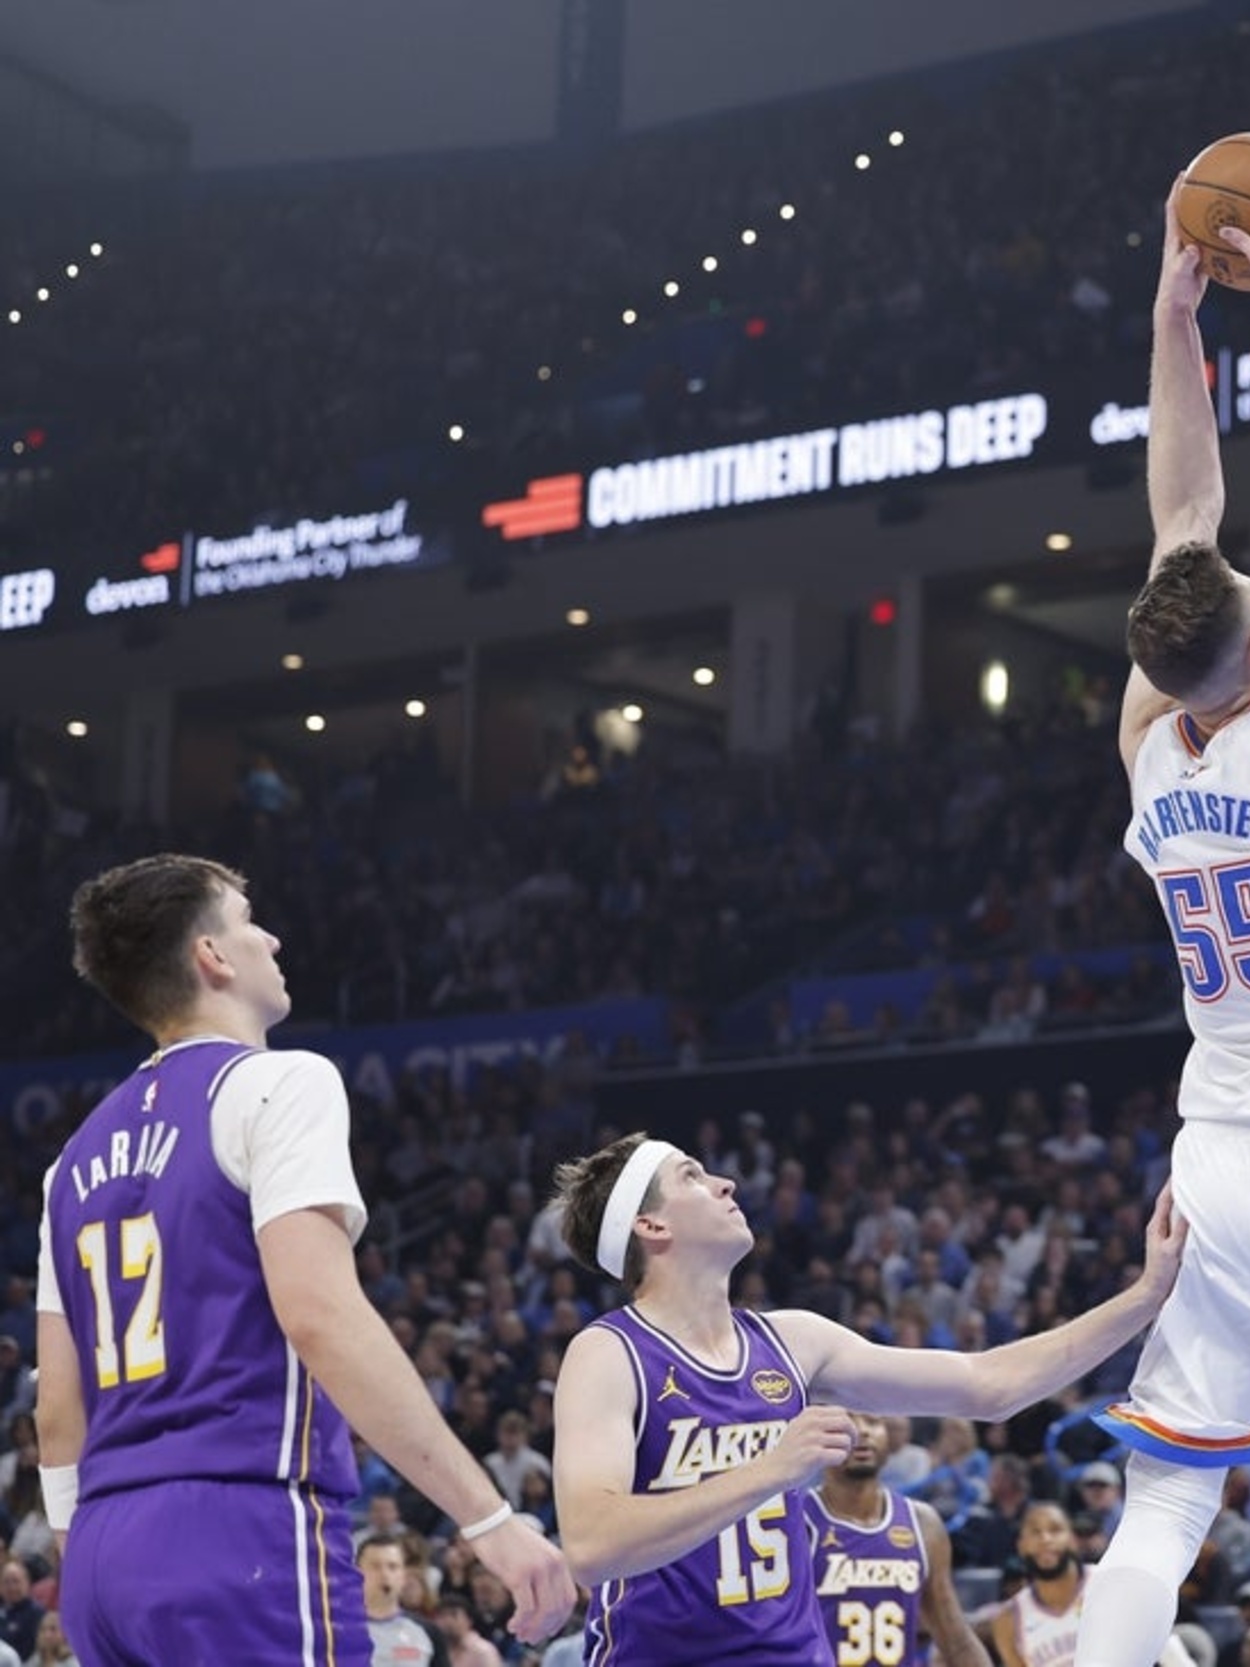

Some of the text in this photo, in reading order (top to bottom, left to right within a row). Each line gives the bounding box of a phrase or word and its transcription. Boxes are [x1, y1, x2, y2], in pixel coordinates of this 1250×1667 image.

[588, 393, 1047, 529] COMMITMENT RUNS DEEP
[197, 499, 407, 567] Founding Partner of
[0, 568, 54, 630] EEP
[86, 577, 169, 615] devon
[77, 1211, 167, 1389] 12
[648, 1416, 789, 1490] LAKER
[716, 1492, 791, 1607] 15
[816, 1553, 920, 1595] LAKERS
[838, 1600, 906, 1667] 36
